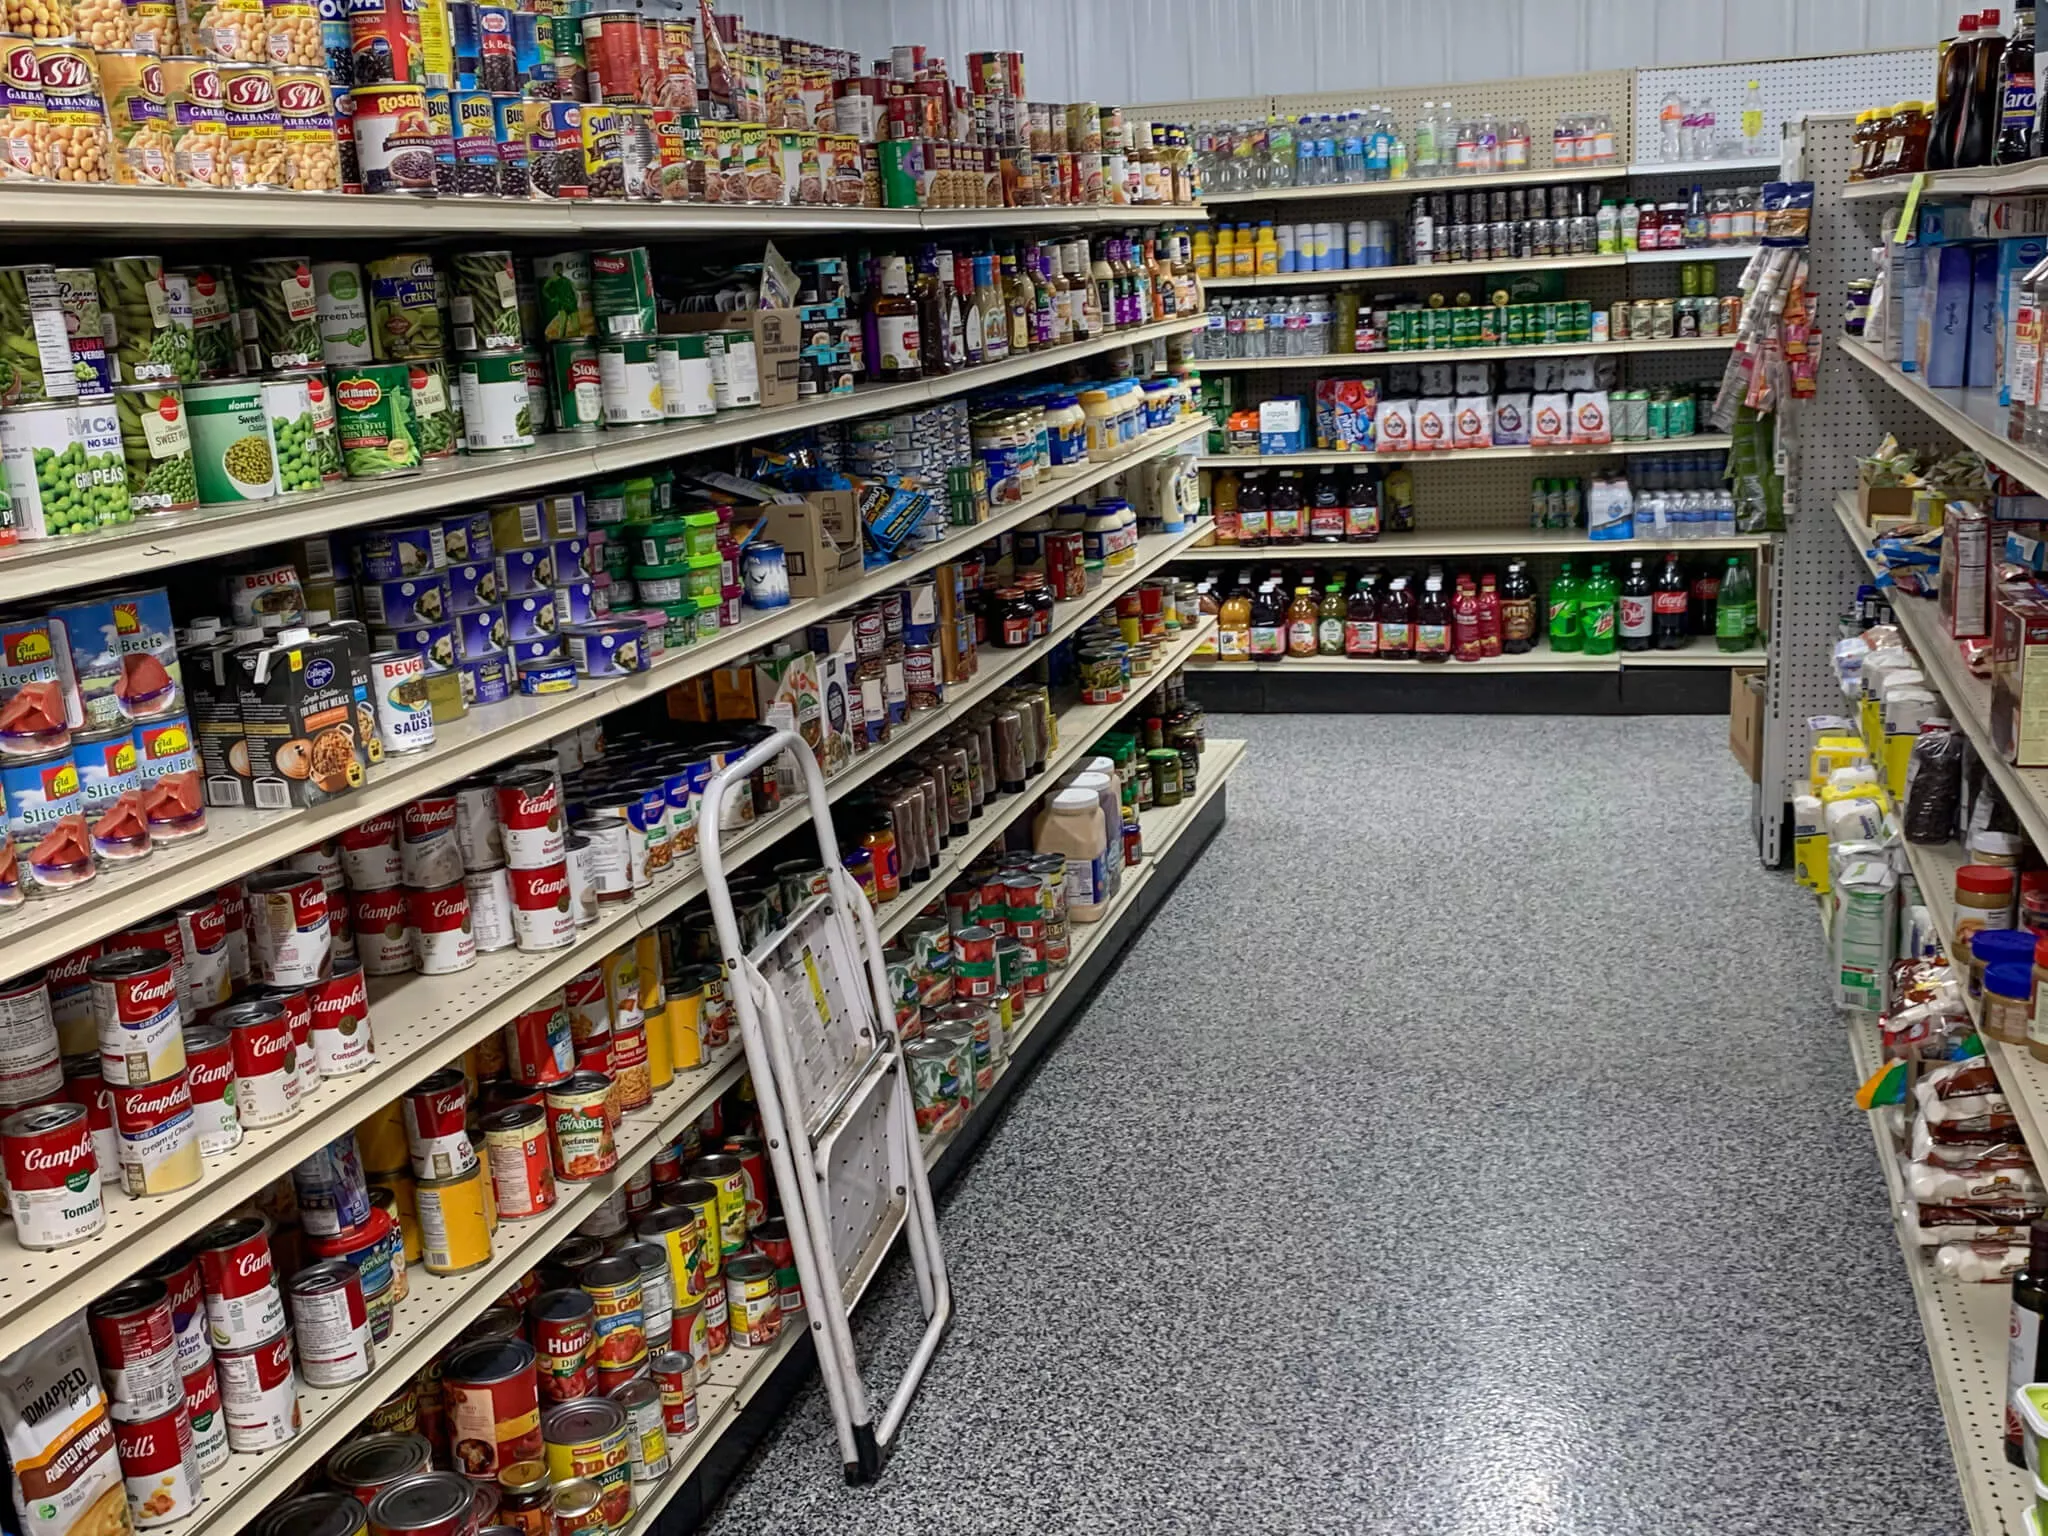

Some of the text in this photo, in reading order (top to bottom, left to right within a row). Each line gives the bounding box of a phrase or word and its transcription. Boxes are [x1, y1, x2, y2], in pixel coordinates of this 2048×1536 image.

[232, 128, 250, 139] Low
[351, 388, 377, 398] Monte
[87, 435, 119, 448] NO SALT
[93, 466, 125, 487] PEAS
[121, 637, 163, 655] Beets
[331, 694, 350, 708] MEALS
[87, 778, 133, 800] Sliced
[23, 804, 73, 825] Sliced
[139, 1017, 160, 1030] GREAT
[147, 1022, 171, 1044] Cream
[343, 1038, 360, 1051] Beef
[130, 1061, 147, 1072] MORE
[130, 1070, 148, 1082] CREAM
[555, 1116, 604, 1133] BOYARDEE
[134, 1128, 158, 1142] GREAT
[142, 1136, 169, 1155] Cream
[74, 1222, 98, 1237] SOUP
[140, 1348, 153, 1360] 170
[178, 1342, 201, 1359] Stars
[571, 1458, 605, 1478] RED
